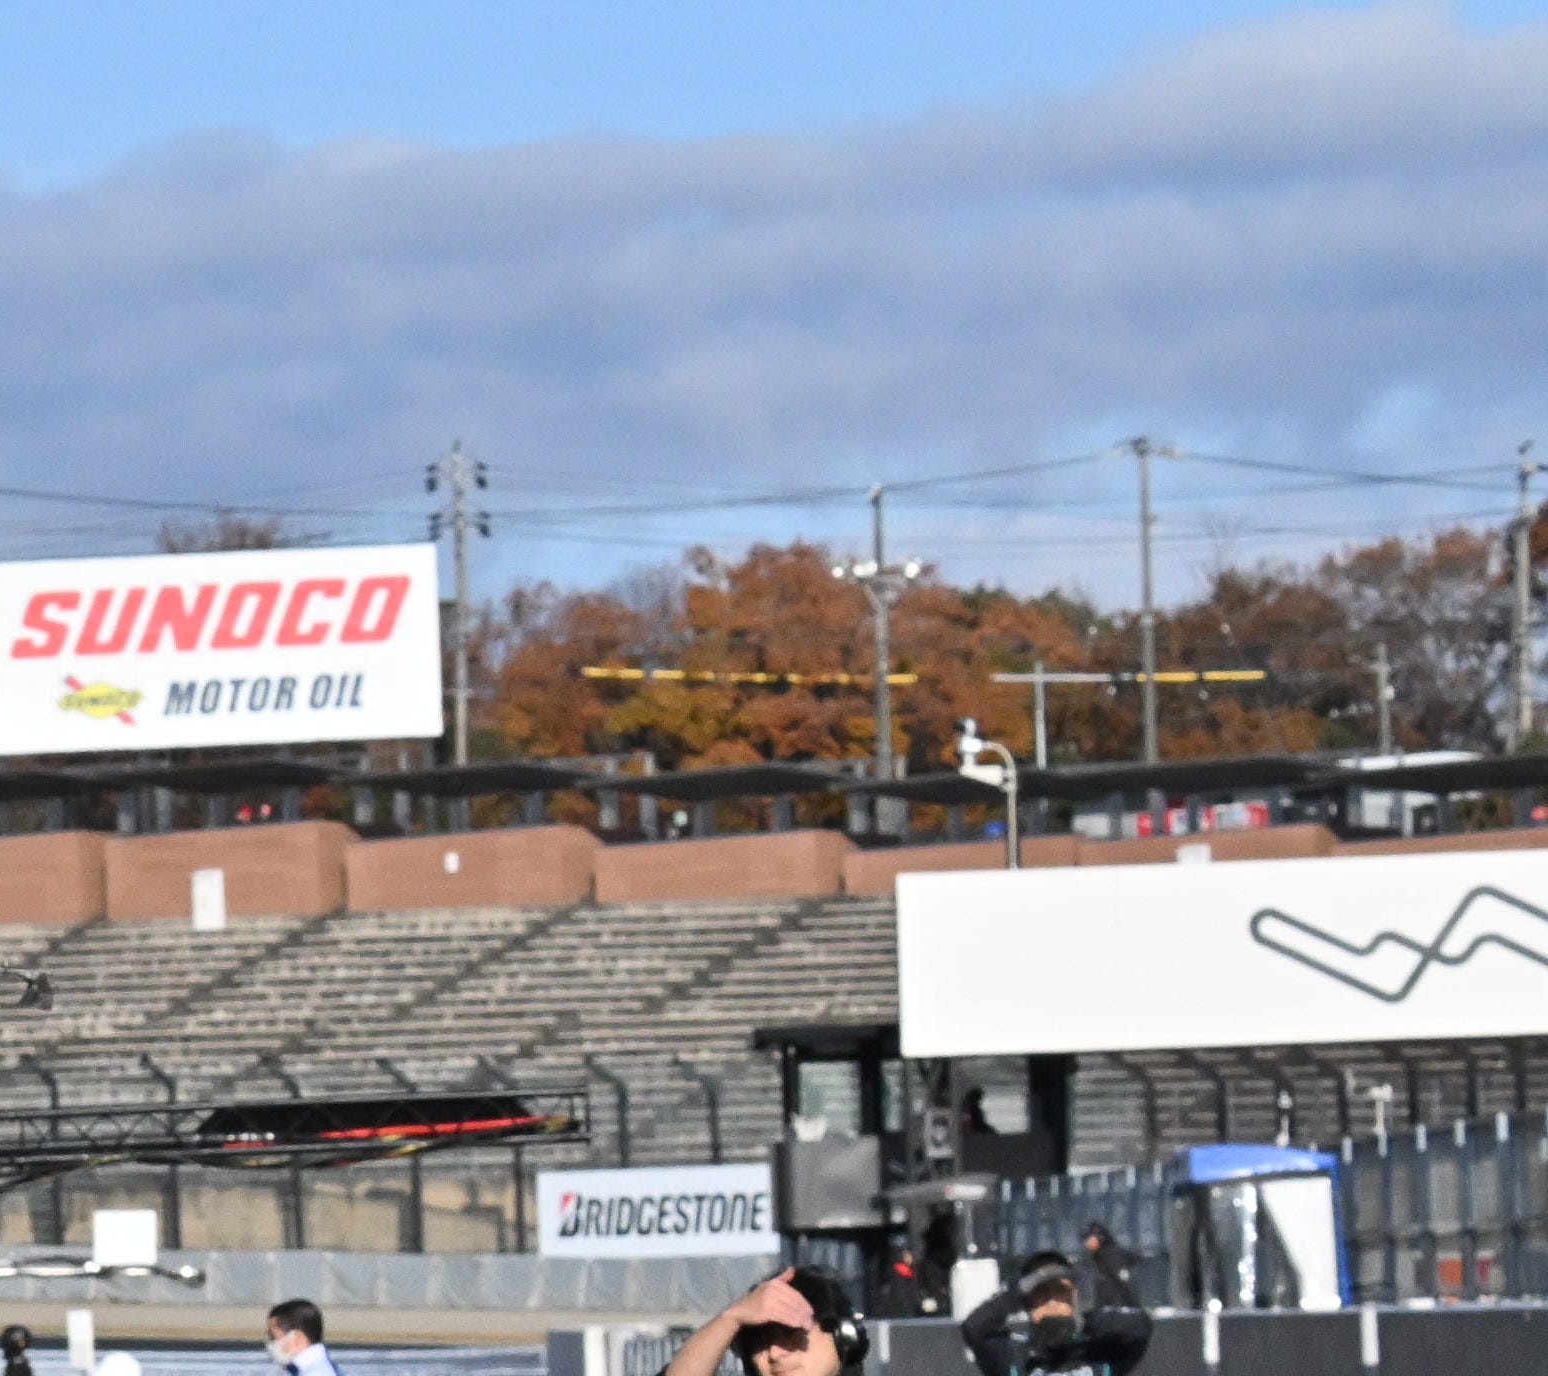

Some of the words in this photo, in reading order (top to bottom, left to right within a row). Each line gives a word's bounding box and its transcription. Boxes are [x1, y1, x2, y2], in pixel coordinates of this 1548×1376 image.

[11, 575, 410, 660] SUNOCO
[163, 674, 295, 717] MOTOR
[306, 671, 365, 713] OIL
[558, 1192, 769, 1238] BRIDGESTONE
